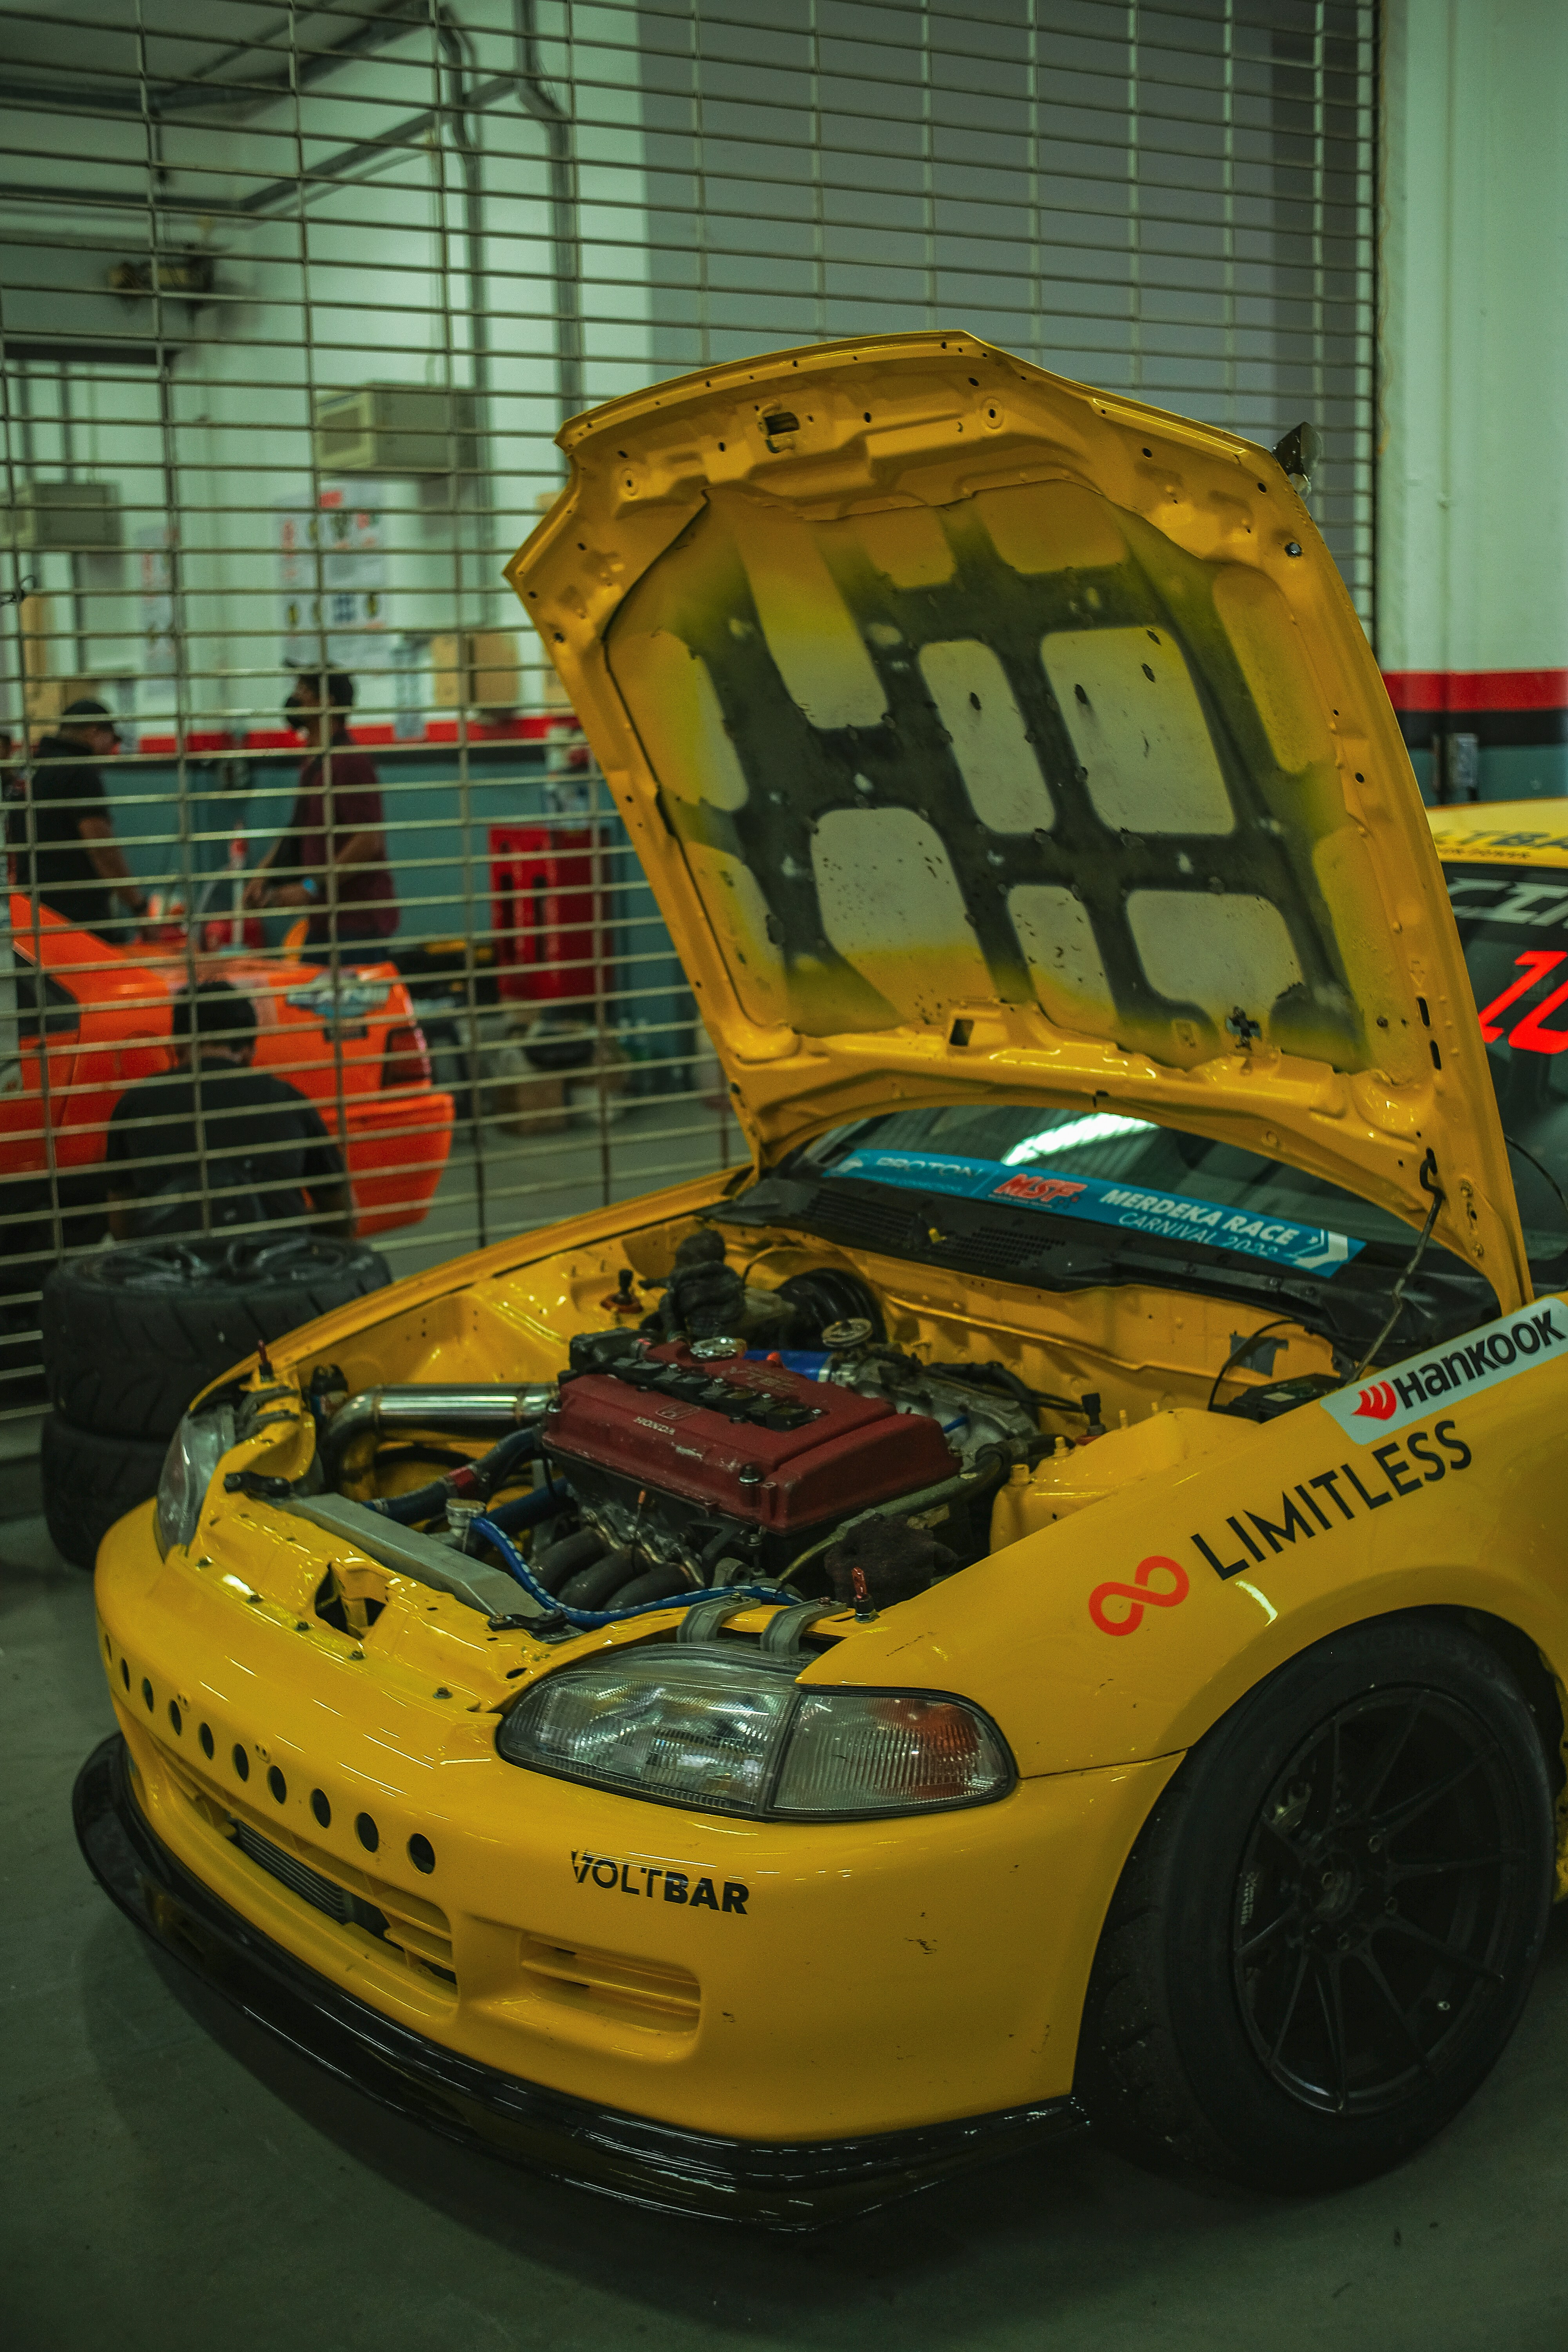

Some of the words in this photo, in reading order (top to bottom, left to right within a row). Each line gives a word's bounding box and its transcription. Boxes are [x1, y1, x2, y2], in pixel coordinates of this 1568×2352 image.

[993, 1173, 1088, 1202] MSF
[1100, 1189, 1222, 1227] MERDEKA
[1222, 1214, 1299, 1246] RACE
[1119, 1212, 1218, 1244] CARNIVAL
[633, 1416, 676, 1436] HONDA
[1191, 1420, 1472, 1581] LIMITLESS
[571, 1849, 750, 1915] VOLTBAR
